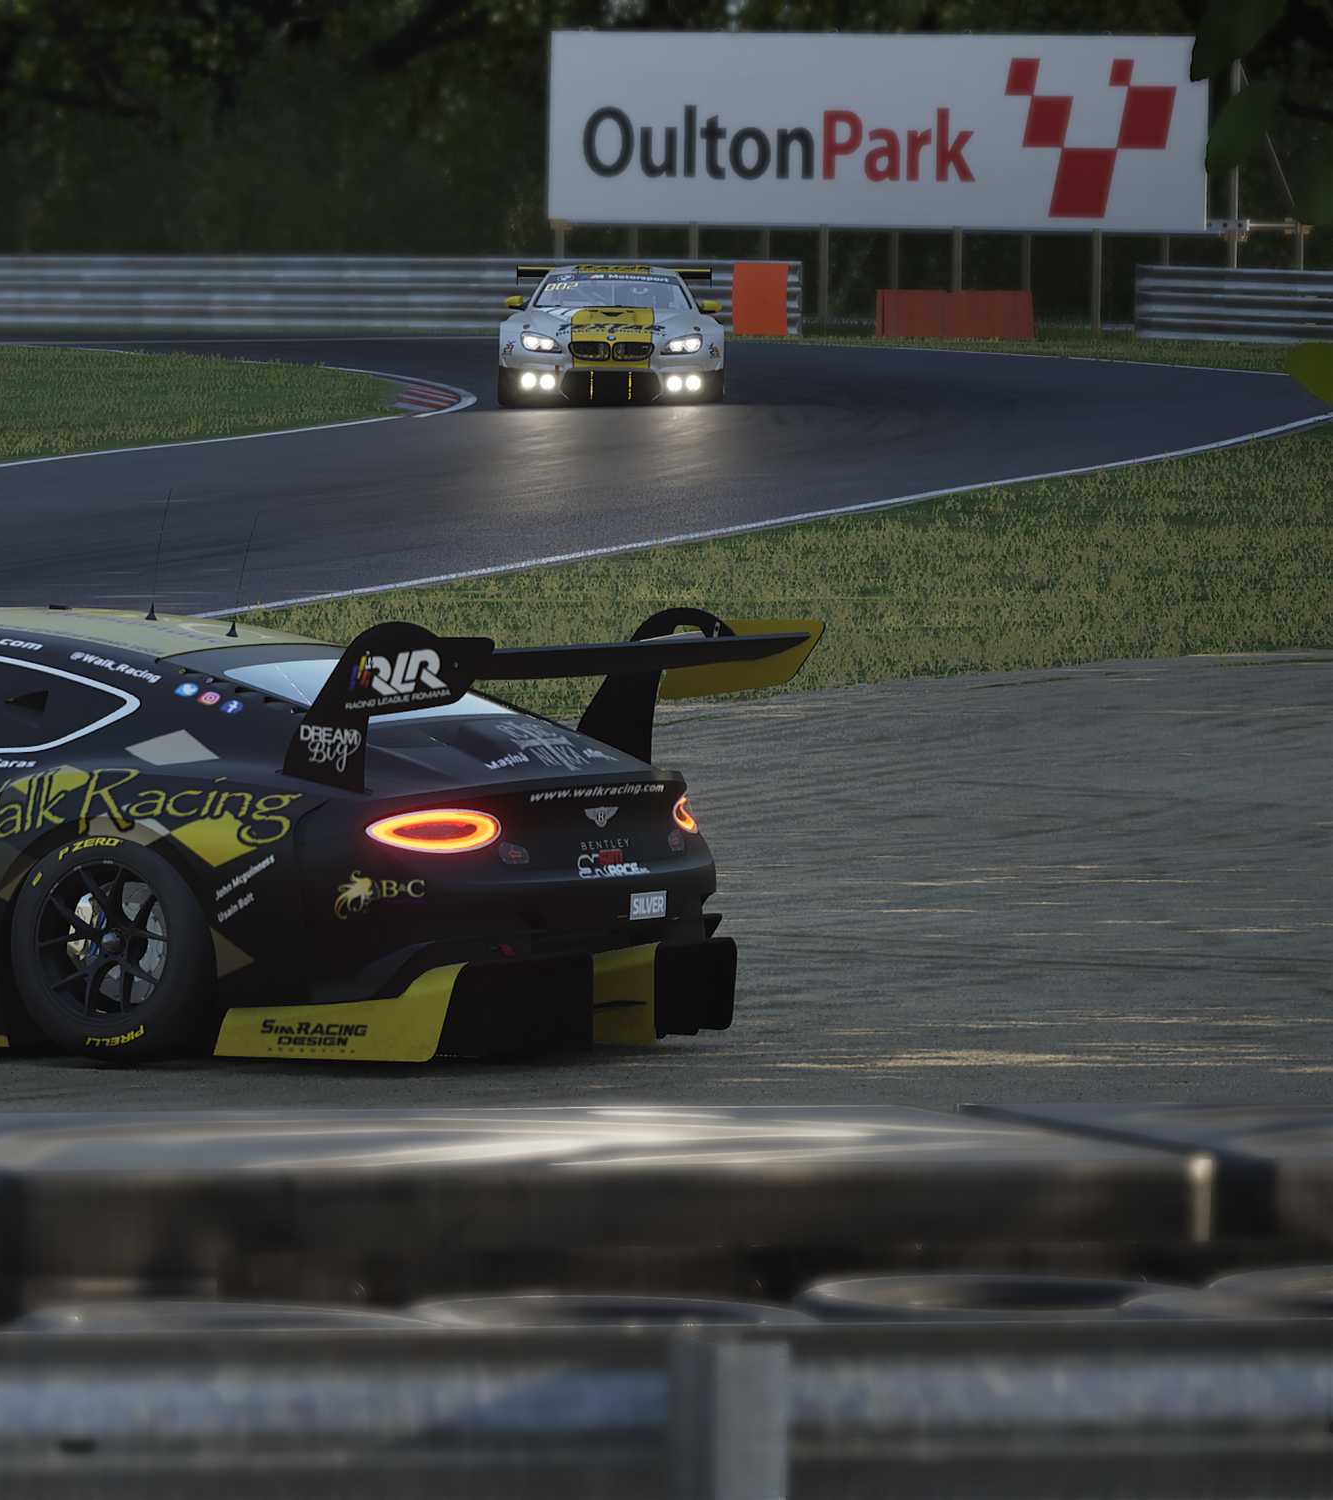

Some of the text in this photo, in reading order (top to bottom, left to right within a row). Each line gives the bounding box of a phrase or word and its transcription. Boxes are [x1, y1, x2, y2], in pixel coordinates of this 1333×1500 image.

[69, 651, 162, 685] @Walk_Racing
[345, 689, 452, 711] RACING LEAGUE ROMANIA
[299, 724, 361, 745] DREAM
[307, 739, 350, 773] Big
[529, 783, 665, 803] www.walkracing.com
[77, 768, 303, 846] Racing
[57, 836, 121, 861] P ZERO
[579, 837, 630, 852] BENTLEY
[217, 904, 238, 923] Usain
[633, 895, 665, 915] SILVER
[84, 1024, 146, 1048] PIRELLI
